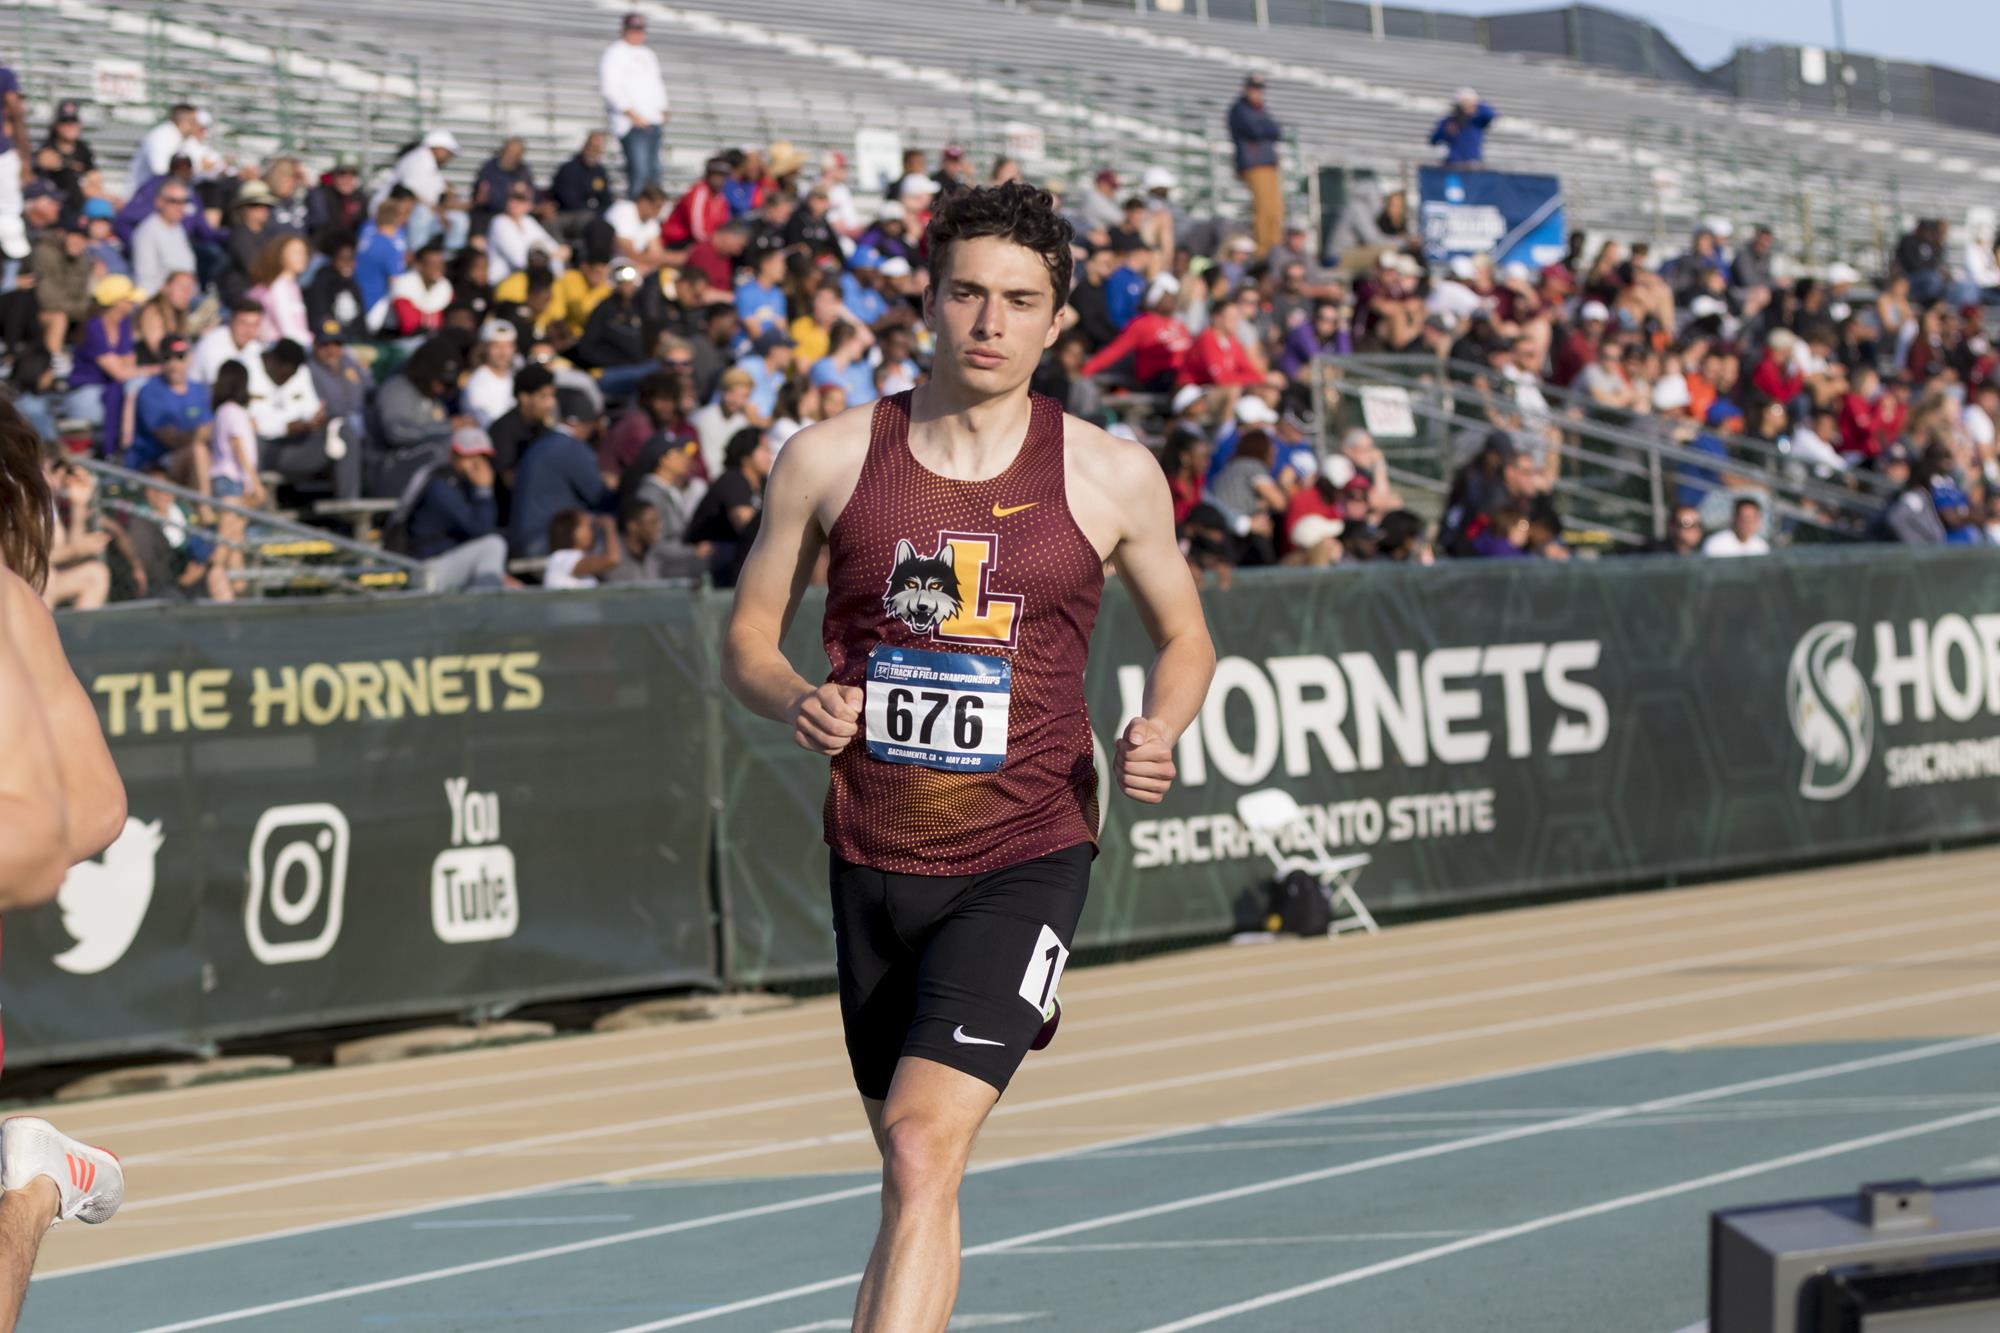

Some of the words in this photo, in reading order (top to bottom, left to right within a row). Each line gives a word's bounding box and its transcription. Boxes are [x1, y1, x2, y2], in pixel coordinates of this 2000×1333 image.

[93, 668, 233, 737] THE
[249, 652, 544, 726] HORNETS
[890, 667, 912, 678] TRACK
[918, 670, 938, 680] FIELD
[939, 672, 1000, 685] CHAMPIONSHIPS
[886, 688, 984, 749] 676
[929, 753, 936, 761] CA
[945, 756, 960, 764] MAY
[444, 777, 500, 846] You
[1388, 788, 1496, 842] STATE
[442, 864, 507, 924] Tube
[1039, 944, 1060, 1009] 1
